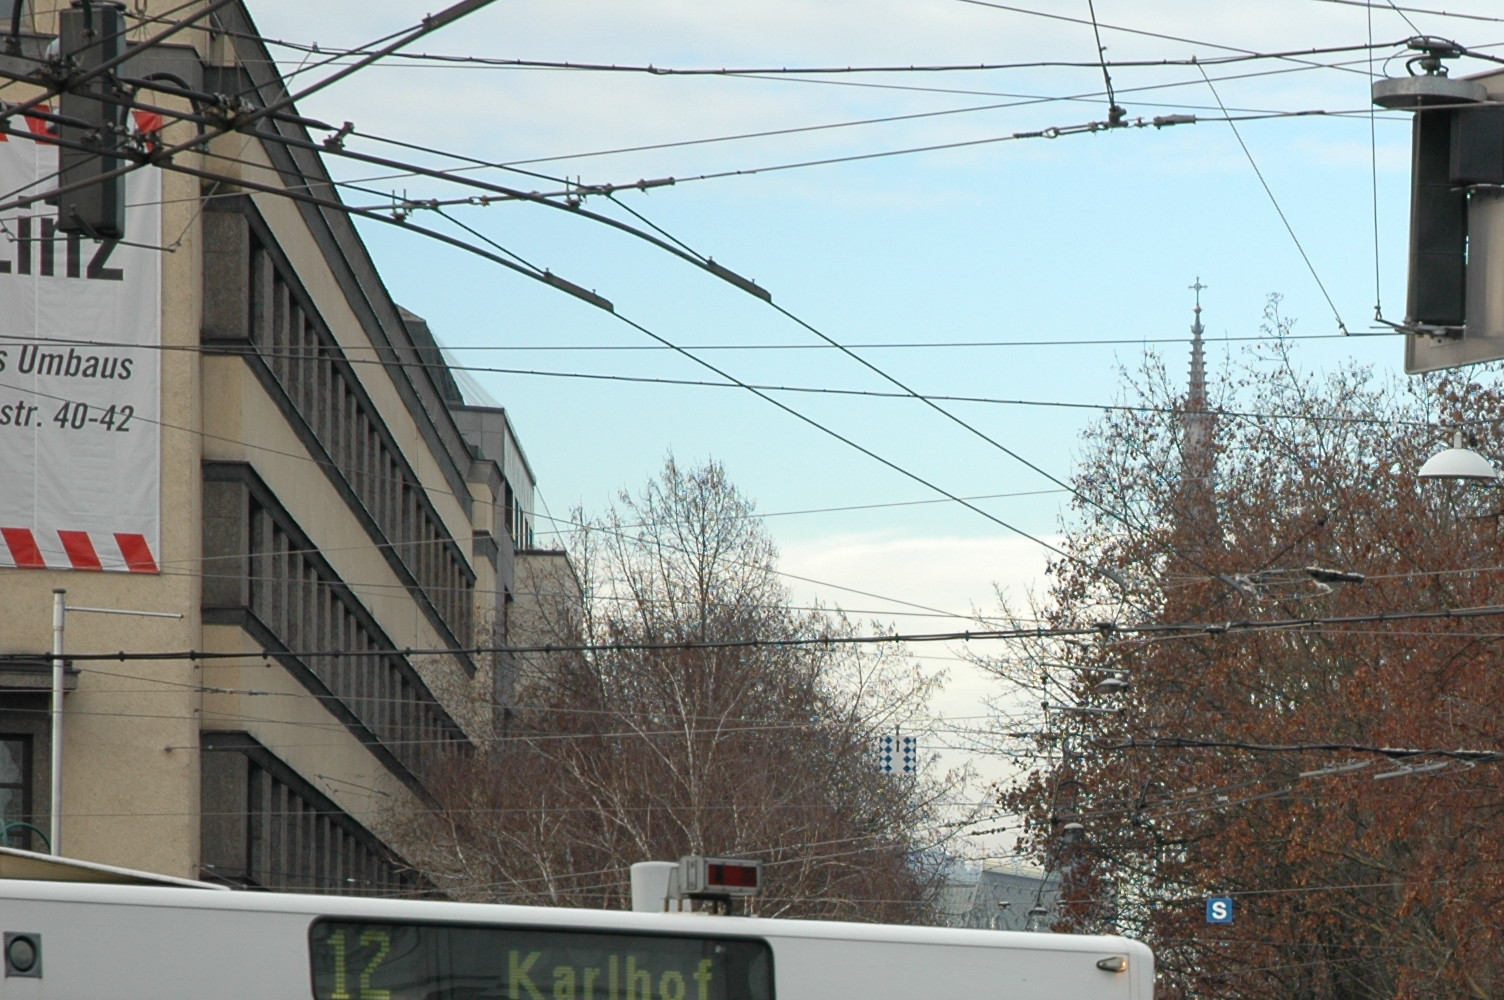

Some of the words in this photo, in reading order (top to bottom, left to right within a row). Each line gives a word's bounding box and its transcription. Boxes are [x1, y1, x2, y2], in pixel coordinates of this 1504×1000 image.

[18, 344, 134, 380] Umbaus
[53, 401, 134, 432] 40-42
[1212, 901, 1227, 920] S
[327, 929, 392, 1000] 12
